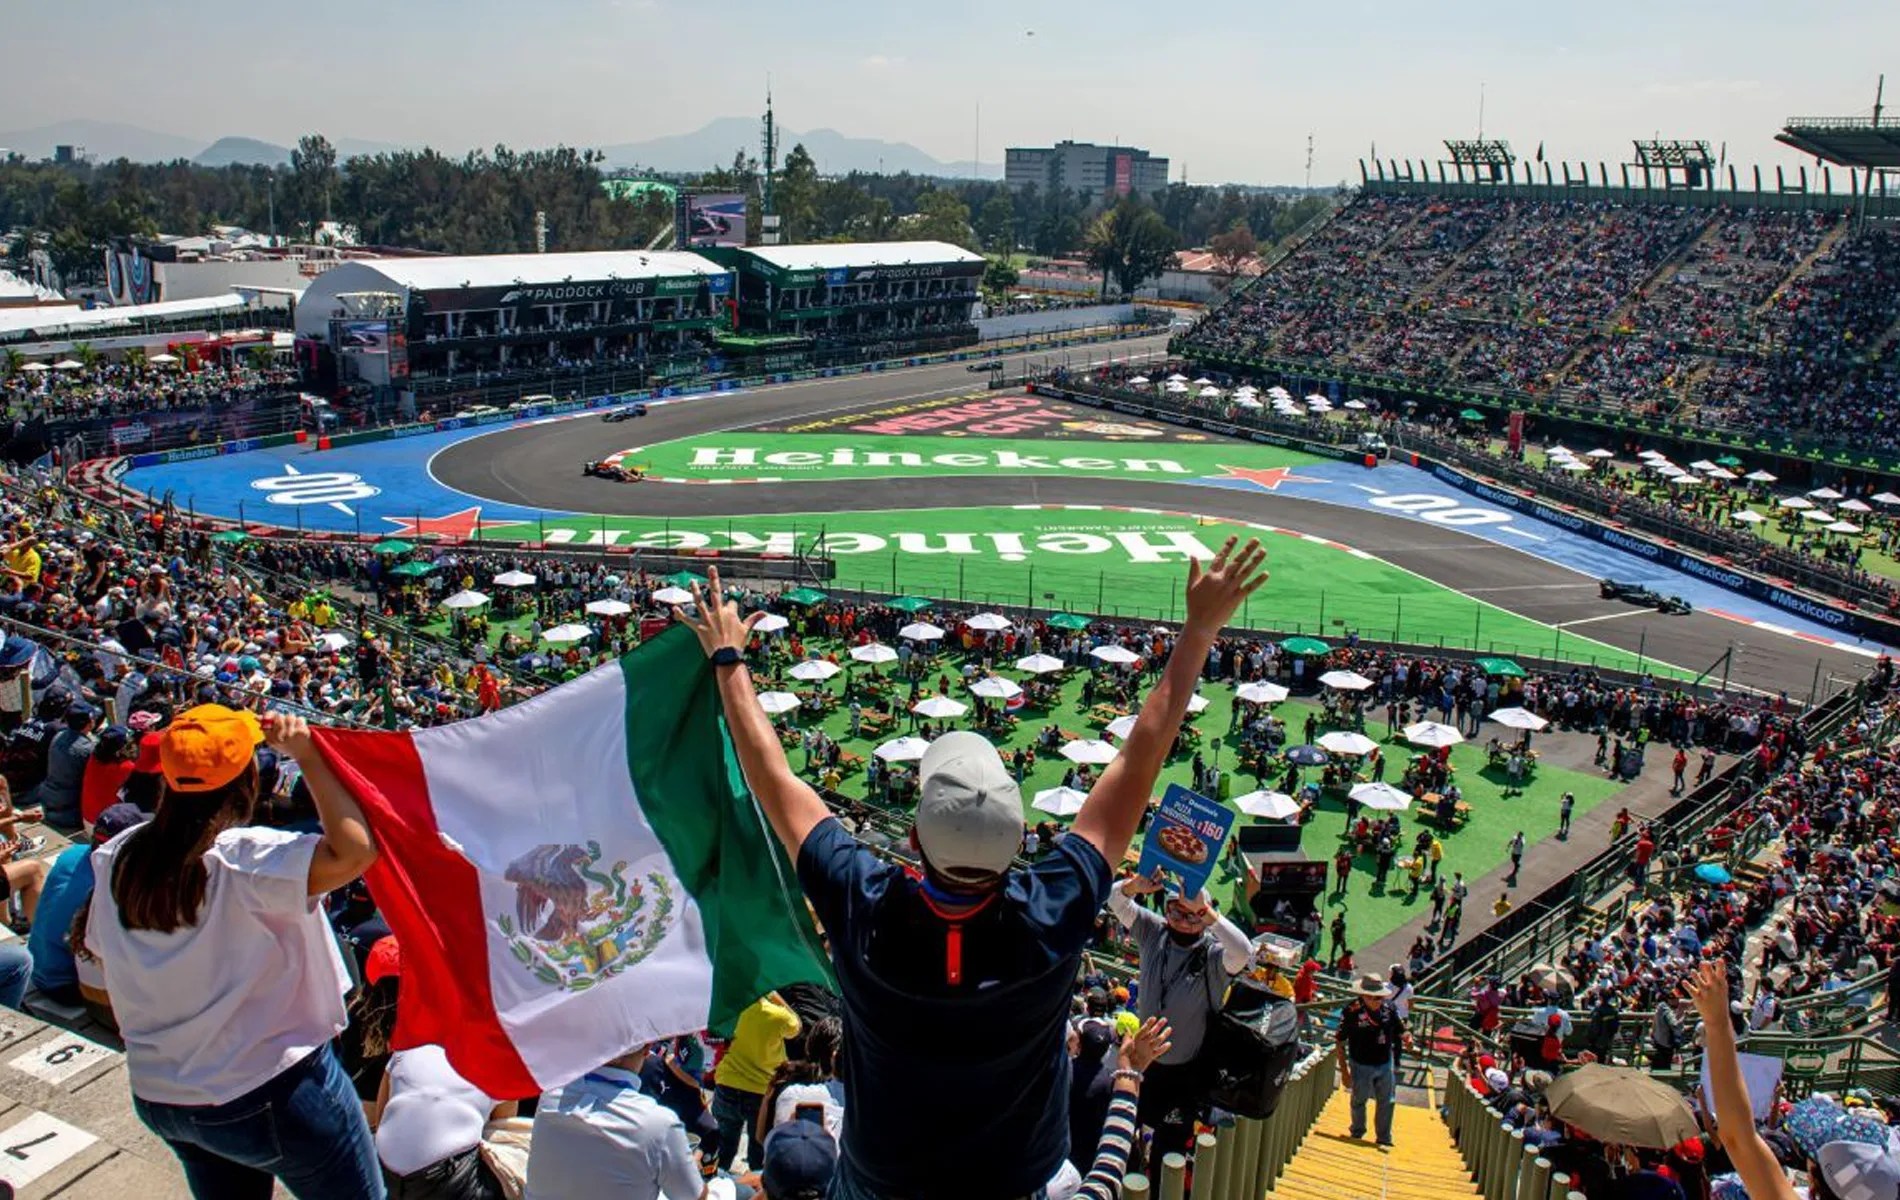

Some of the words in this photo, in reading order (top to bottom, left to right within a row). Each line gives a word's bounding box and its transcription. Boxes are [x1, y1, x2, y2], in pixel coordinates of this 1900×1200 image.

[534, 285, 605, 301] PADDOCK
[849, 396, 1042, 435] MEXICO
[967, 409, 1075, 435] CITY
[168, 446, 217, 463] Heineken
[687, 446, 1192, 473] Heineken
[1535, 506, 1585, 531] #MexicoGP
[540, 527, 1217, 563] Heineken
[1603, 529, 1659, 558] #MexicoGP
[1680, 556, 1745, 588] #MexicoGP
[1770, 589, 1846, 626] #MexicoGP
[1173, 800, 1192, 816] PIZZA
[1188, 798, 1219, 818] Domino's
[4, 1131, 58, 1161] 7
